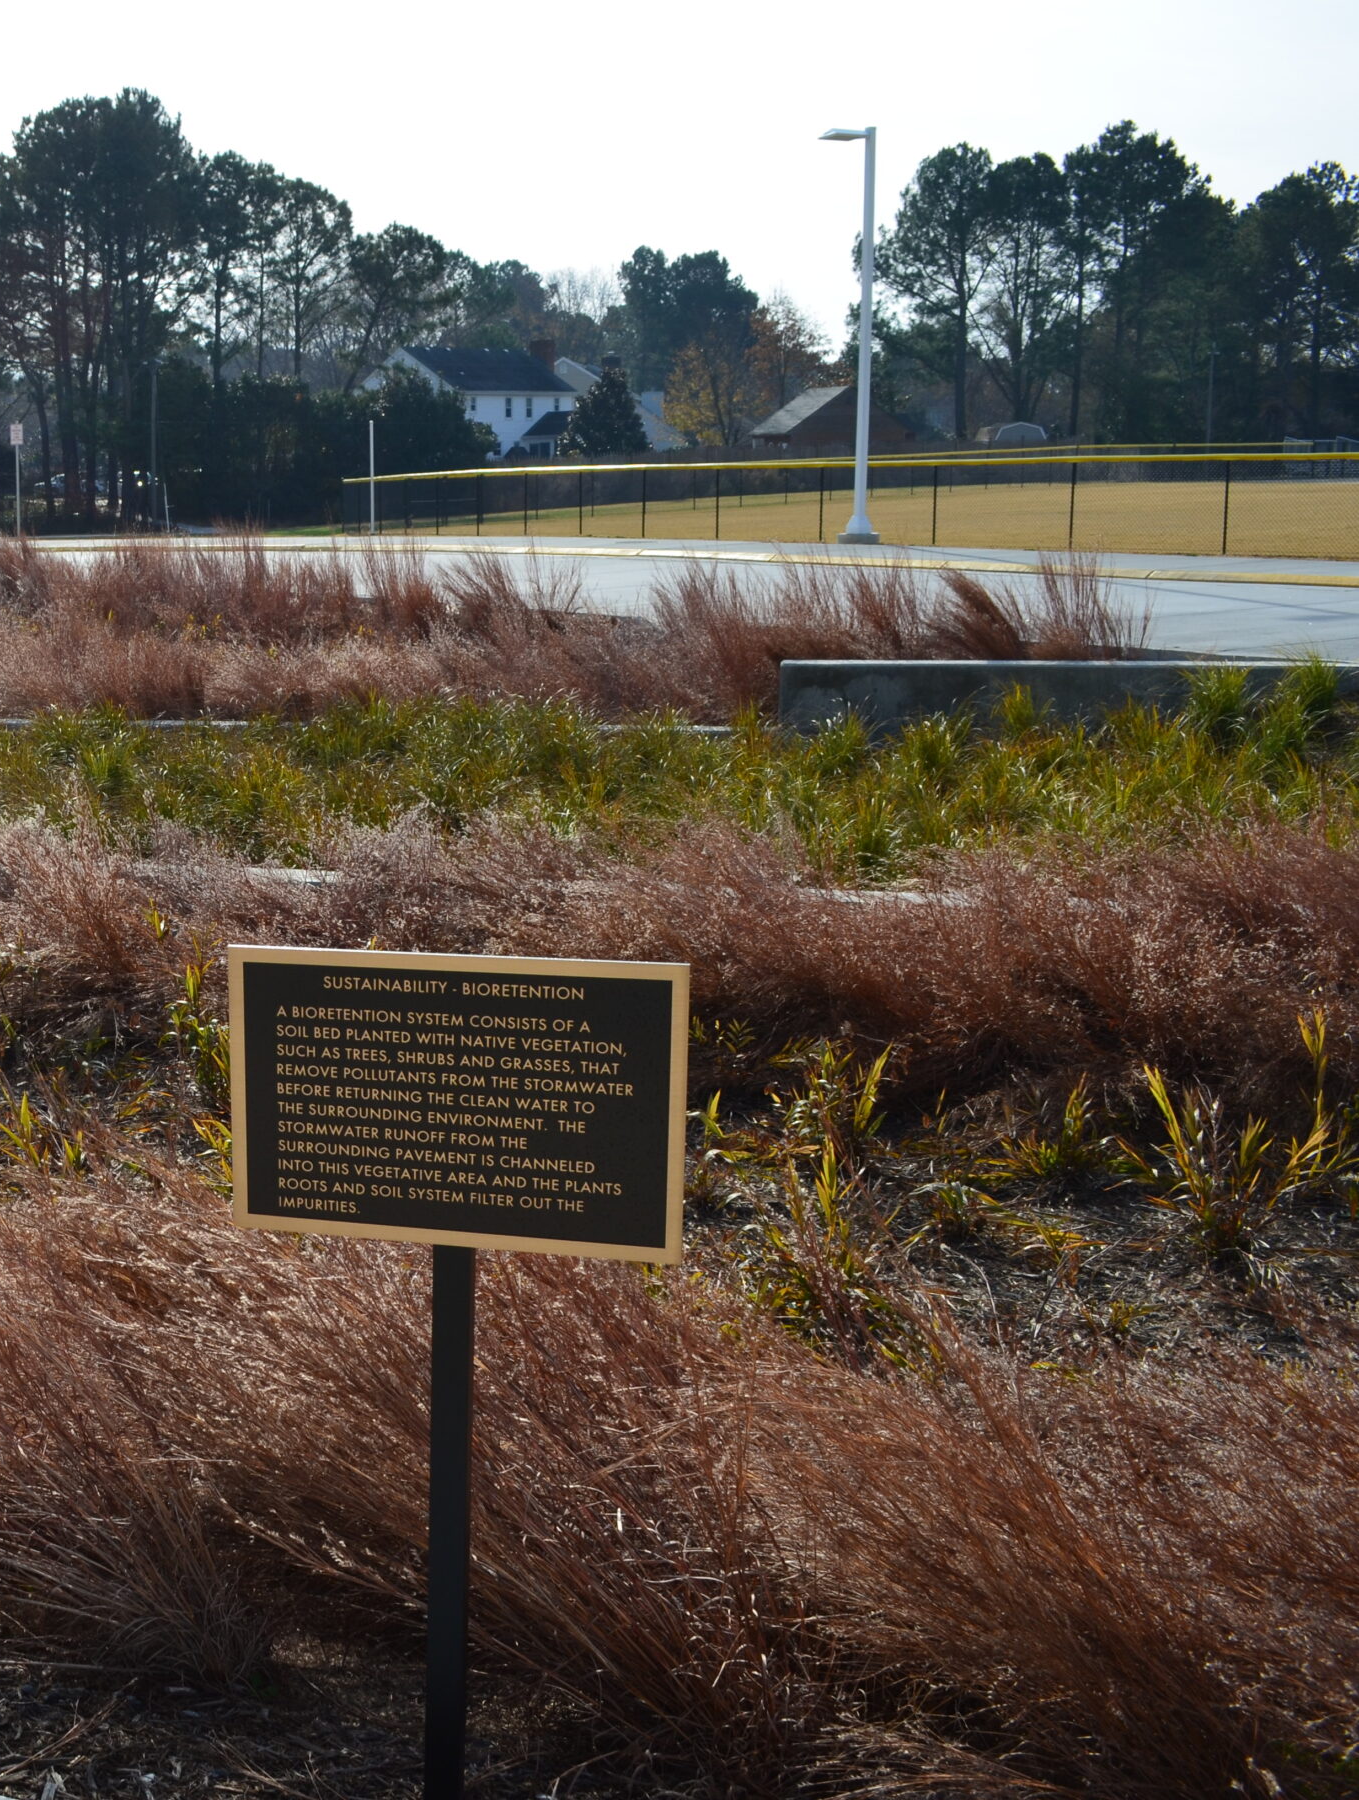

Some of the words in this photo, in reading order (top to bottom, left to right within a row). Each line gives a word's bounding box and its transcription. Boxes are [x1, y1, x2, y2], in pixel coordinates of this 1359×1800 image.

[323, 976, 448, 994] SUSTAINABILITY
[463, 982, 584, 1000] BIORETENTION
[277, 1006, 287, 1017] A
[292, 1007, 401, 1023] BIORETENTION
[407, 1012, 464, 1026] SYSTEM
[470, 1015, 547, 1031] CONSISTS
[553, 1020, 575, 1032] OF
[580, 1022, 590, 1032] A
[277, 1025, 308, 1037] SOIL
[314, 1027, 340, 1040] BED
[346, 1029, 411, 1043] PLANTED
[417, 1032, 454, 1046] WITH
[461, 1035, 516, 1049] NATIVE
[521, 1038, 627, 1057] VEGETATION,
[277, 1044, 316, 1057] SUCH
[322, 1047, 340, 1059] AS
[345, 1048, 391, 1064] TREES,
[397, 1051, 454, 1066] SHRUBS
[460, 1055, 494, 1068] AND
[500, 1057, 575, 1074] GRASSES,
[581, 1061, 620, 1075] THAT
[277, 1064, 338, 1079] REMOVE
[343, 1068, 436, 1085] POLLUTANTS
[442, 1074, 485, 1087] FROM
[491, 1076, 518, 1090] THE
[524, 1079, 633, 1097] STORMWATER
[277, 1083, 330, 1097] BEFORE
[336, 1086, 422, 1103] RETURNING
[427, 1092, 454, 1105] THE
[460, 1094, 509, 1109] CLEAN
[515, 1098, 568, 1112] WATER
[574, 1101, 595, 1114] TO
[278, 1102, 303, 1115] THE
[309, 1104, 422, 1123] SURROUNDING
[426, 1112, 548, 1131] ENVIRONMENT.
[558, 1120, 586, 1133] THE
[278, 1121, 378, 1139] STORMWATER
[385, 1128, 445, 1143] RUNOFF
[451, 1133, 494, 1147] FROM
[500, 1136, 527, 1149] THE
[279, 1140, 390, 1159] SURROUNDING
[396, 1149, 476, 1165] PAVEMENT
[482, 1154, 494, 1166] IS
[500, 1156, 595, 1173] CHANNELED
[278, 1159, 313, 1172] INTO
[319, 1161, 349, 1175] THIS
[354, 1164, 442, 1182] VEGETATIVE
[447, 1172, 487, 1185] AREA
[492, 1175, 527, 1188] AND
[532, 1178, 559, 1191] THE
[565, 1180, 622, 1196] PLANTS
[279, 1177, 327, 1192] ROOTS
[333, 1182, 365, 1195] AND
[371, 1185, 403, 1199] SOIL
[409, 1188, 464, 1203] SYSTEM
[470, 1192, 514, 1207] FILTER
[520, 1196, 552, 1210] OUT
[557, 1199, 584, 1213] THE
[279, 1196, 361, 1214] IMPURITIES.
